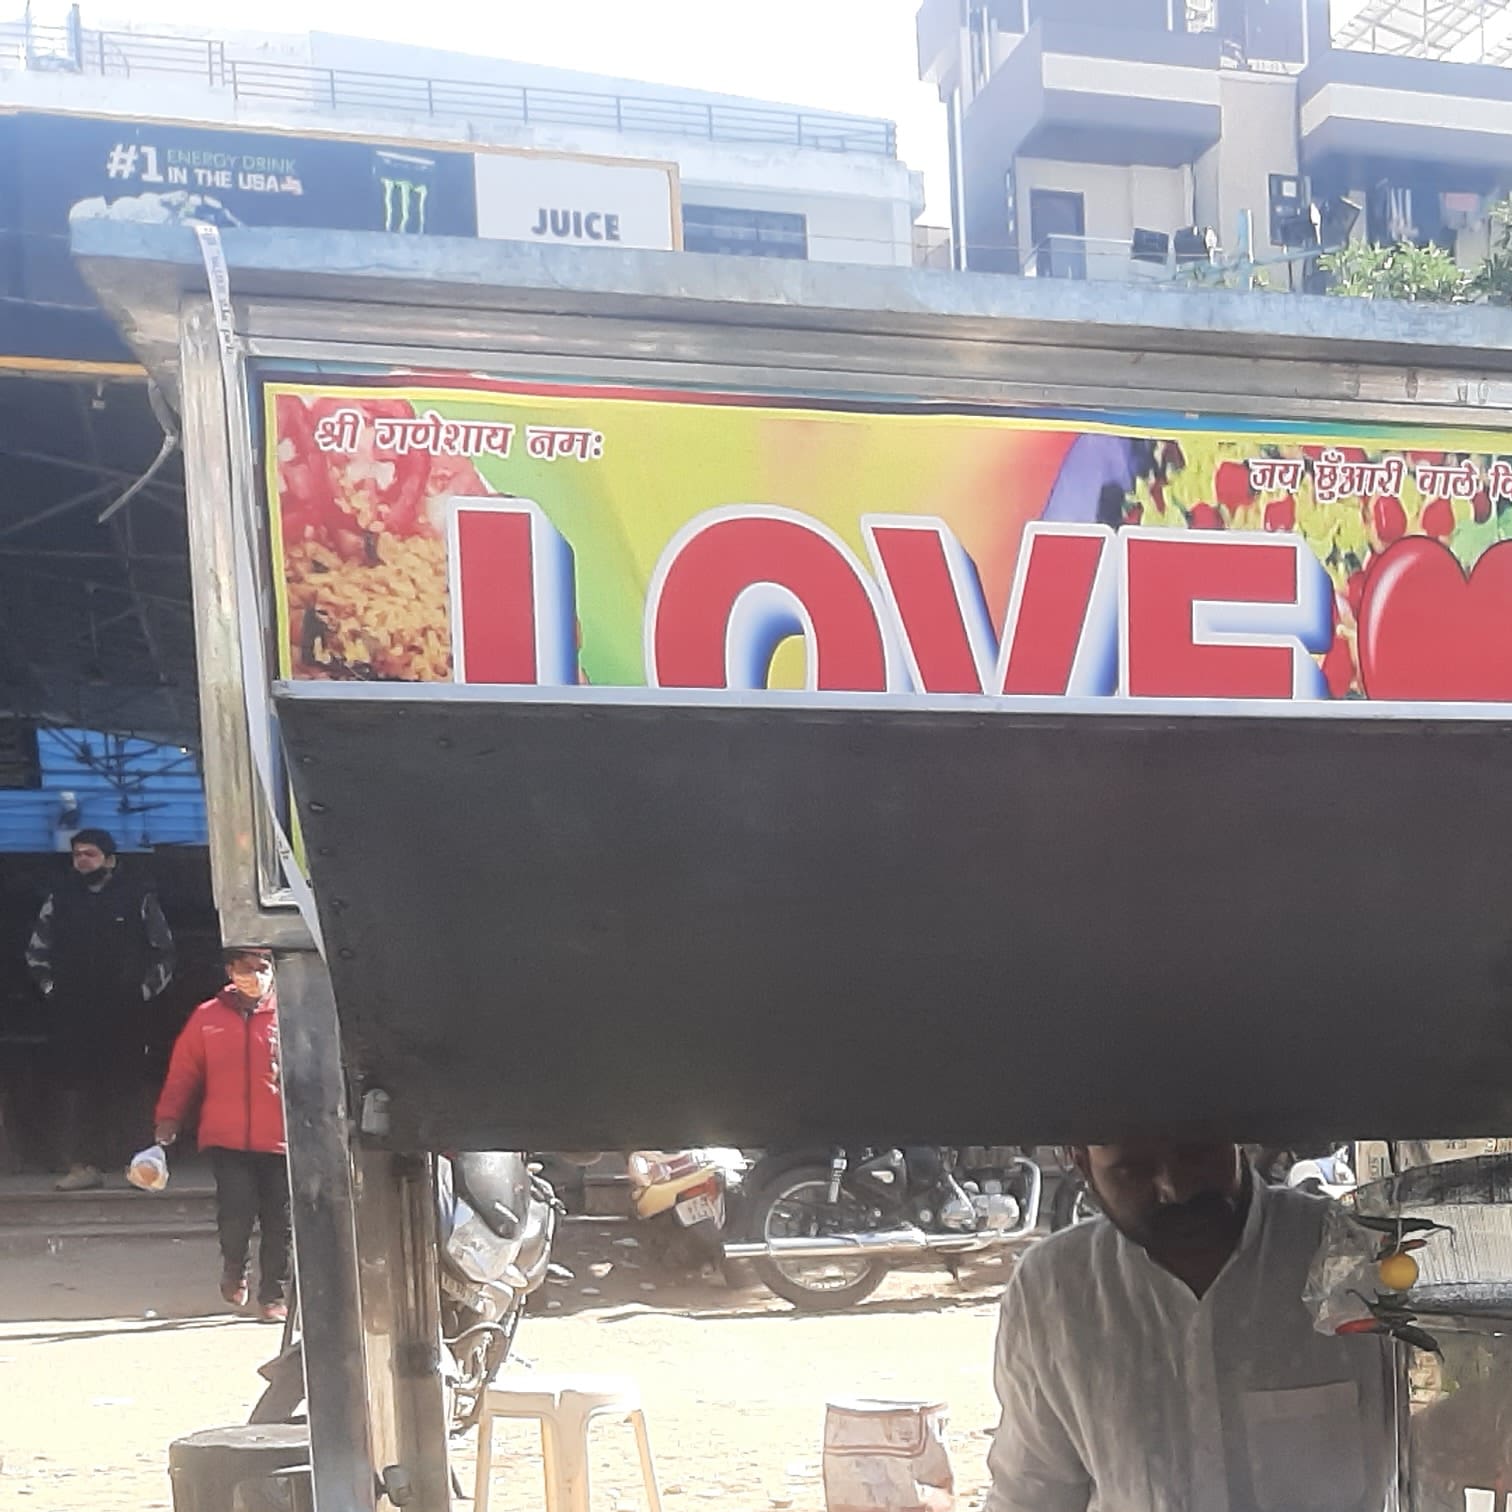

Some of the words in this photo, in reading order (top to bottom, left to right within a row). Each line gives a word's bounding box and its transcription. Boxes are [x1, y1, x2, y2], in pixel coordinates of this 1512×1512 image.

[106, 143, 164, 182] #1
[166, 149, 237, 170] ENERGY
[241, 155, 297, 174] DRINK
[167, 167, 188, 185] IN
[194, 168, 232, 189] THE
[238, 172, 281, 192] USA
[531, 207, 621, 241] JUICE
[315, 409, 363, 451] श्री
[375, 411, 515, 456] गणेशाय
[1251, 459, 1304, 493] जय
[1417, 461, 1480, 499] वाले
[448, 497, 1334, 700] LOVE
